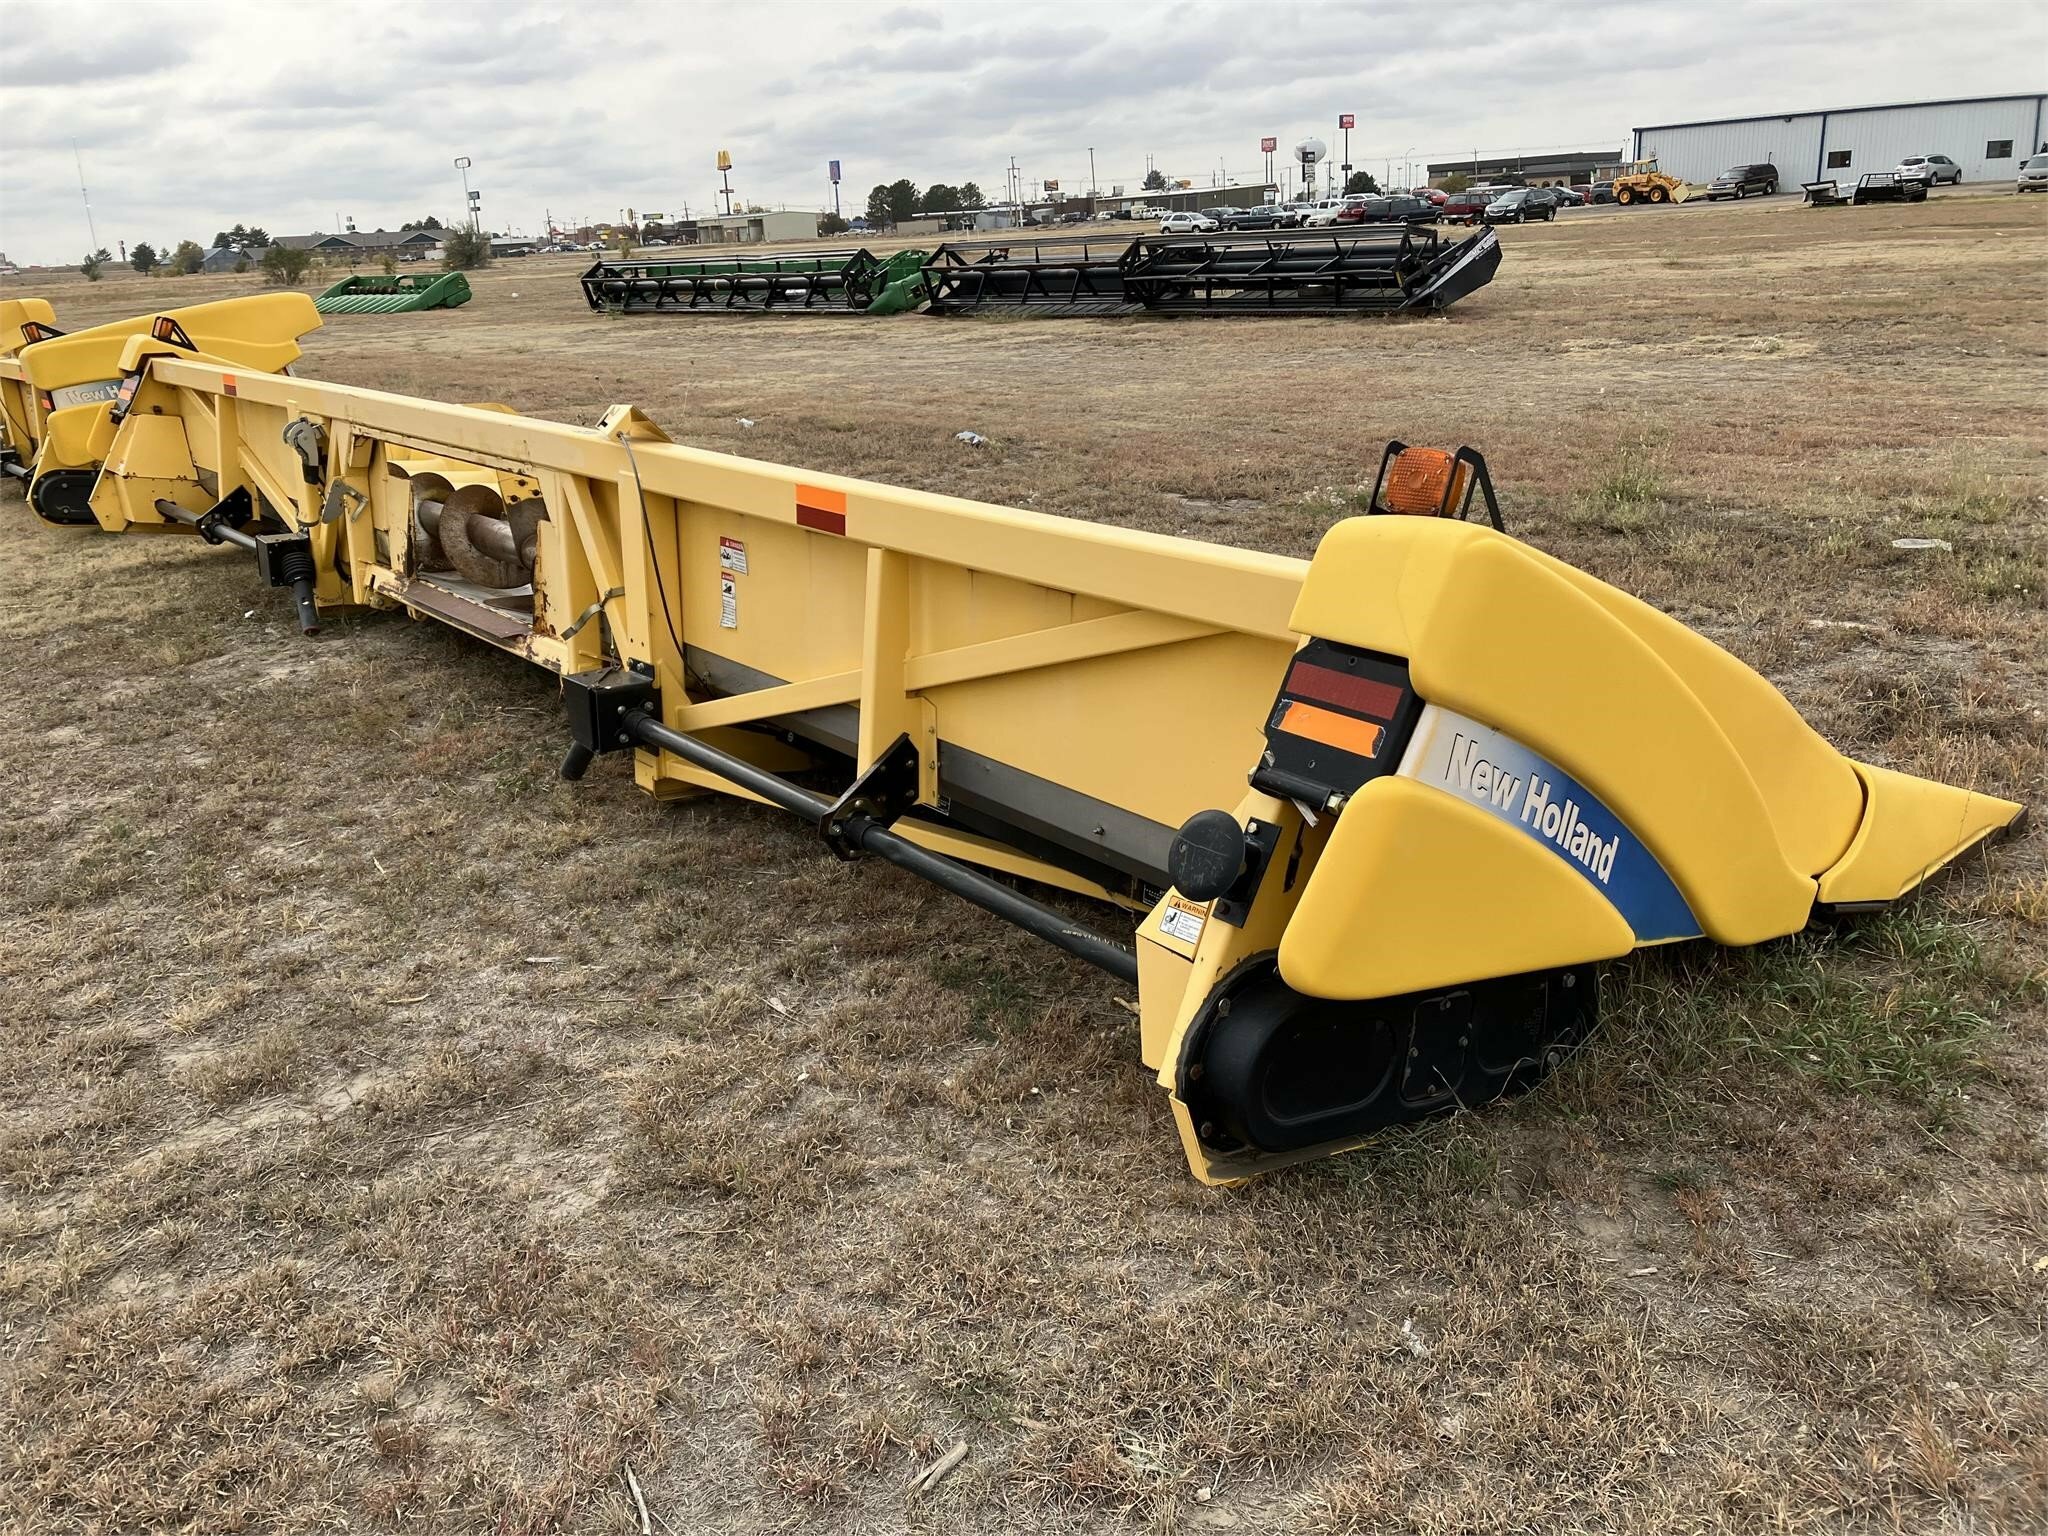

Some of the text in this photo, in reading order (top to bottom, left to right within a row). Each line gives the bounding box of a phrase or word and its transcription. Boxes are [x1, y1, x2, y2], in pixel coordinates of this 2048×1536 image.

[65, 389, 105, 405] New
[1445, 733, 1620, 884] New Holland
[1181, 902, 1207, 917] WARNIN
